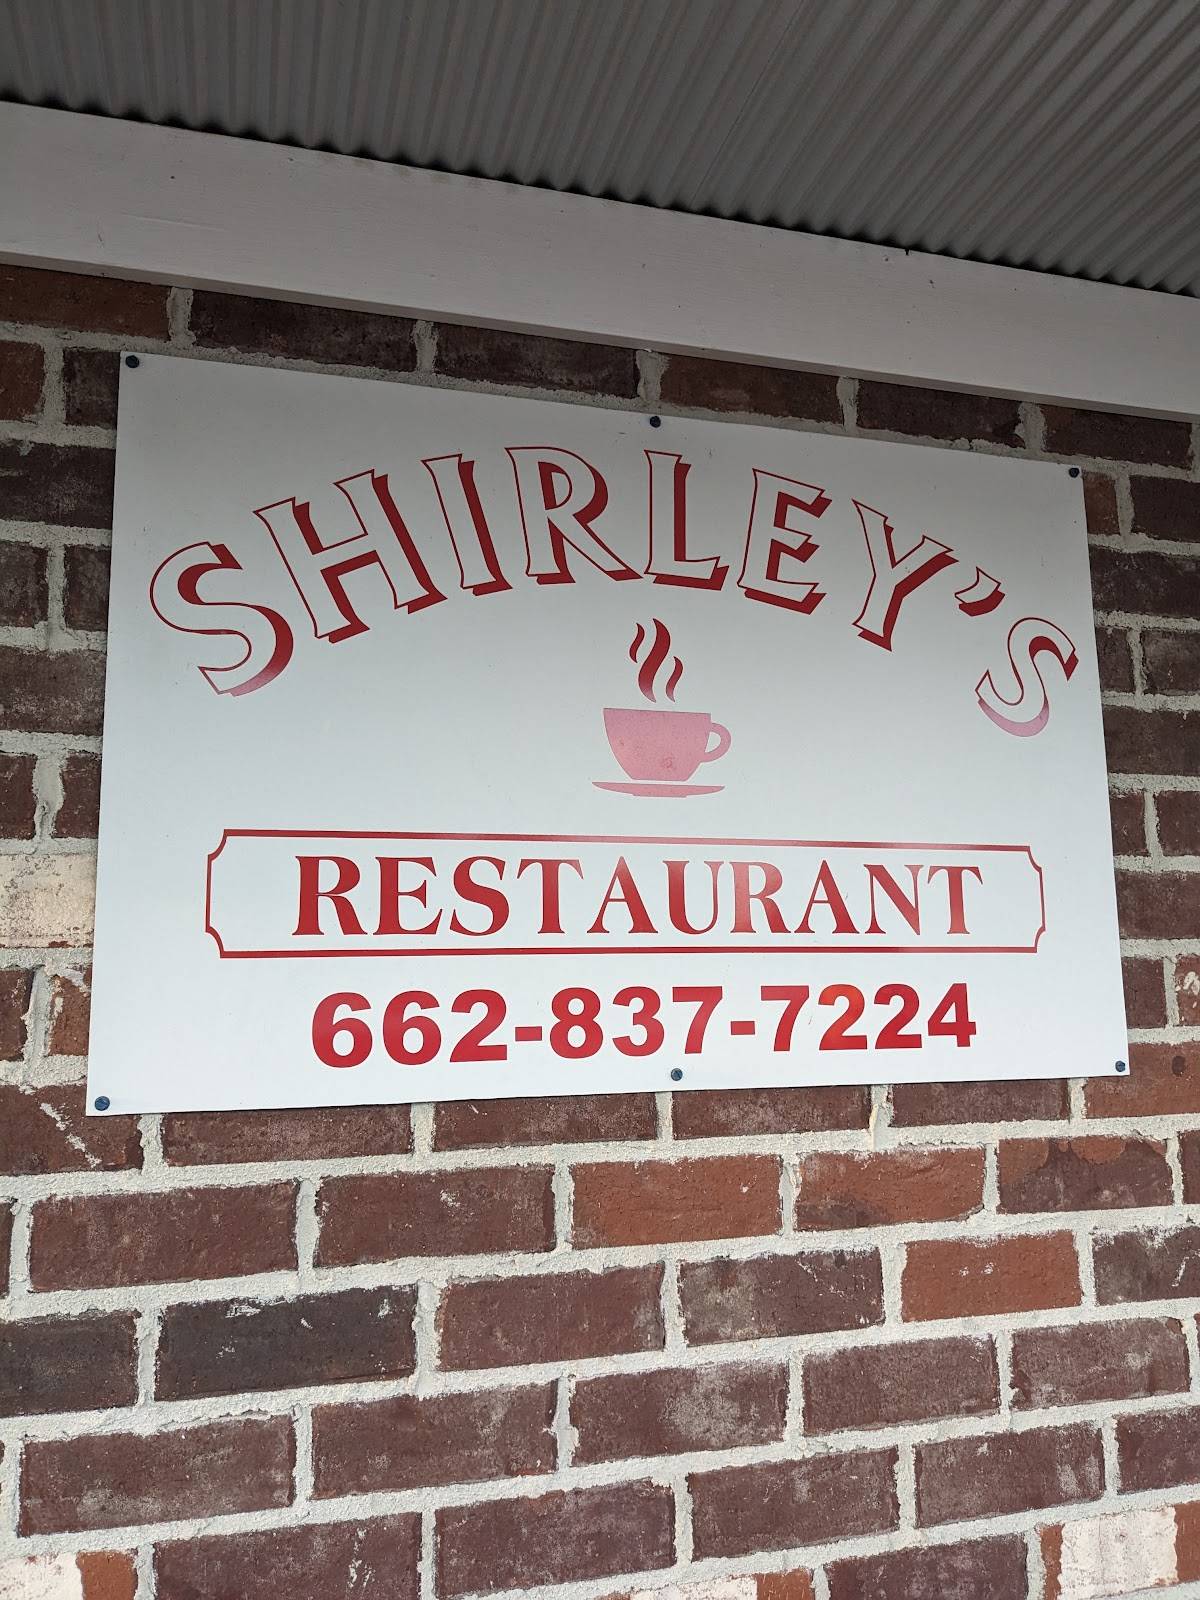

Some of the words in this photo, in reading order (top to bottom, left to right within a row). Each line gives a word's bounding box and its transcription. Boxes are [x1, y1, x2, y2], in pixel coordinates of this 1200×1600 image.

[149, 446, 1078, 737] SHIRLEY'S
[293, 855, 982, 937] RESTAURANT
[312, 983, 978, 1069] 662-837-7224
